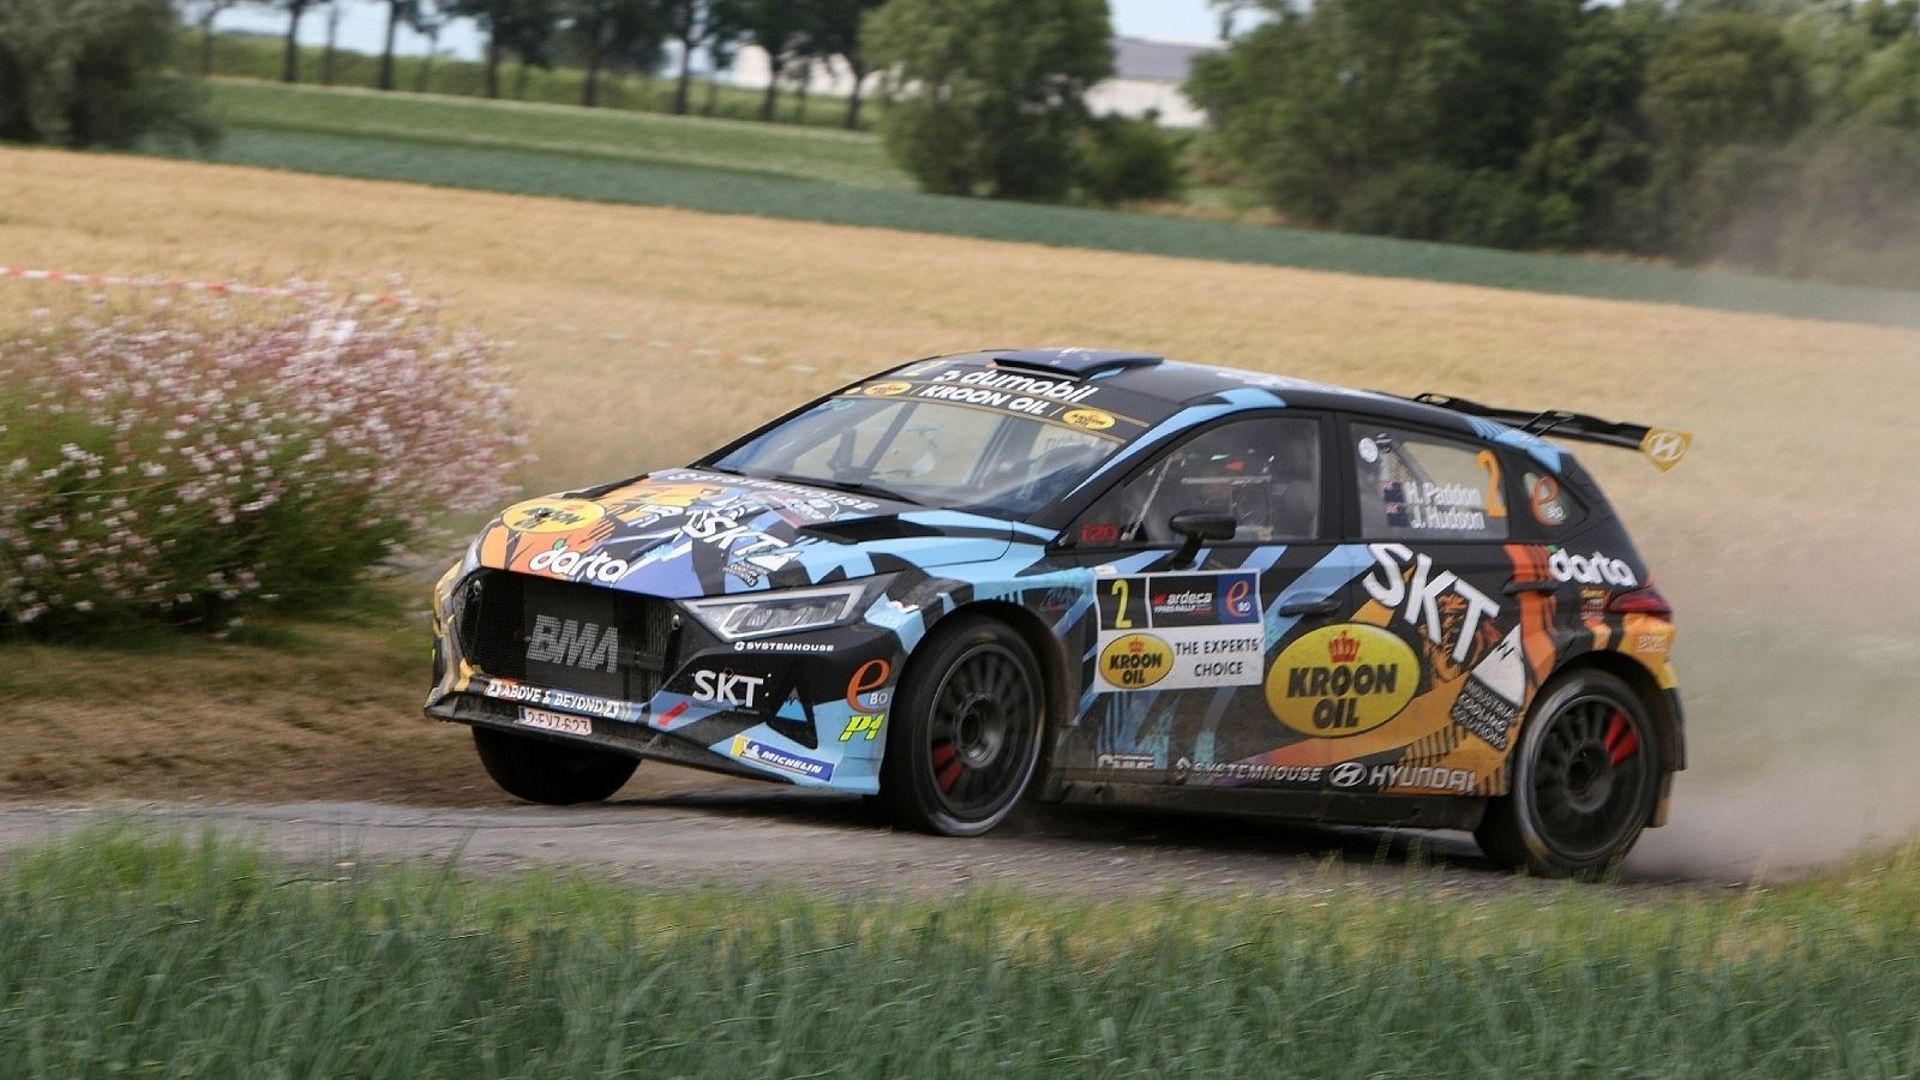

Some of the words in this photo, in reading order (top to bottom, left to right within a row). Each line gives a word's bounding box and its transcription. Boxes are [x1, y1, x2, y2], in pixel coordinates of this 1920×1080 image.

[920, 384, 1011, 406] KROON
[1008, 397, 1050, 415] OIL
[960, 370, 1099, 402] dumobil
[1476, 449, 1507, 516] 2
[1111, 579, 1132, 629] 2
[1167, 590, 1213, 604] ardeca
[1362, 543, 1500, 663] SKT
[526, 614, 619, 673] BMA
[746, 641, 834, 652] SYSTEMHOUSE
[1175, 642, 1202, 656] THE
[1108, 653, 1163, 670] KROON
[1194, 661, 1244, 677] CHOICE
[692, 669, 764, 708] SKT
[1122, 669, 1145, 685] OIL
[1286, 664, 1398, 698] KROON
[500, 684, 541, 703] ABOVE
[541, 690, 552, 704] &
[553, 693, 604, 713] BEYOND
[869, 692, 888, 705] BO
[1313, 694, 1360, 729] OIL
[839, 714, 885, 742] P1
[761, 750, 824, 775] MICHELIN
[1193, 763, 1324, 781] SYSTEMHOUSE
[1369, 765, 1478, 793] HYUNDAI
